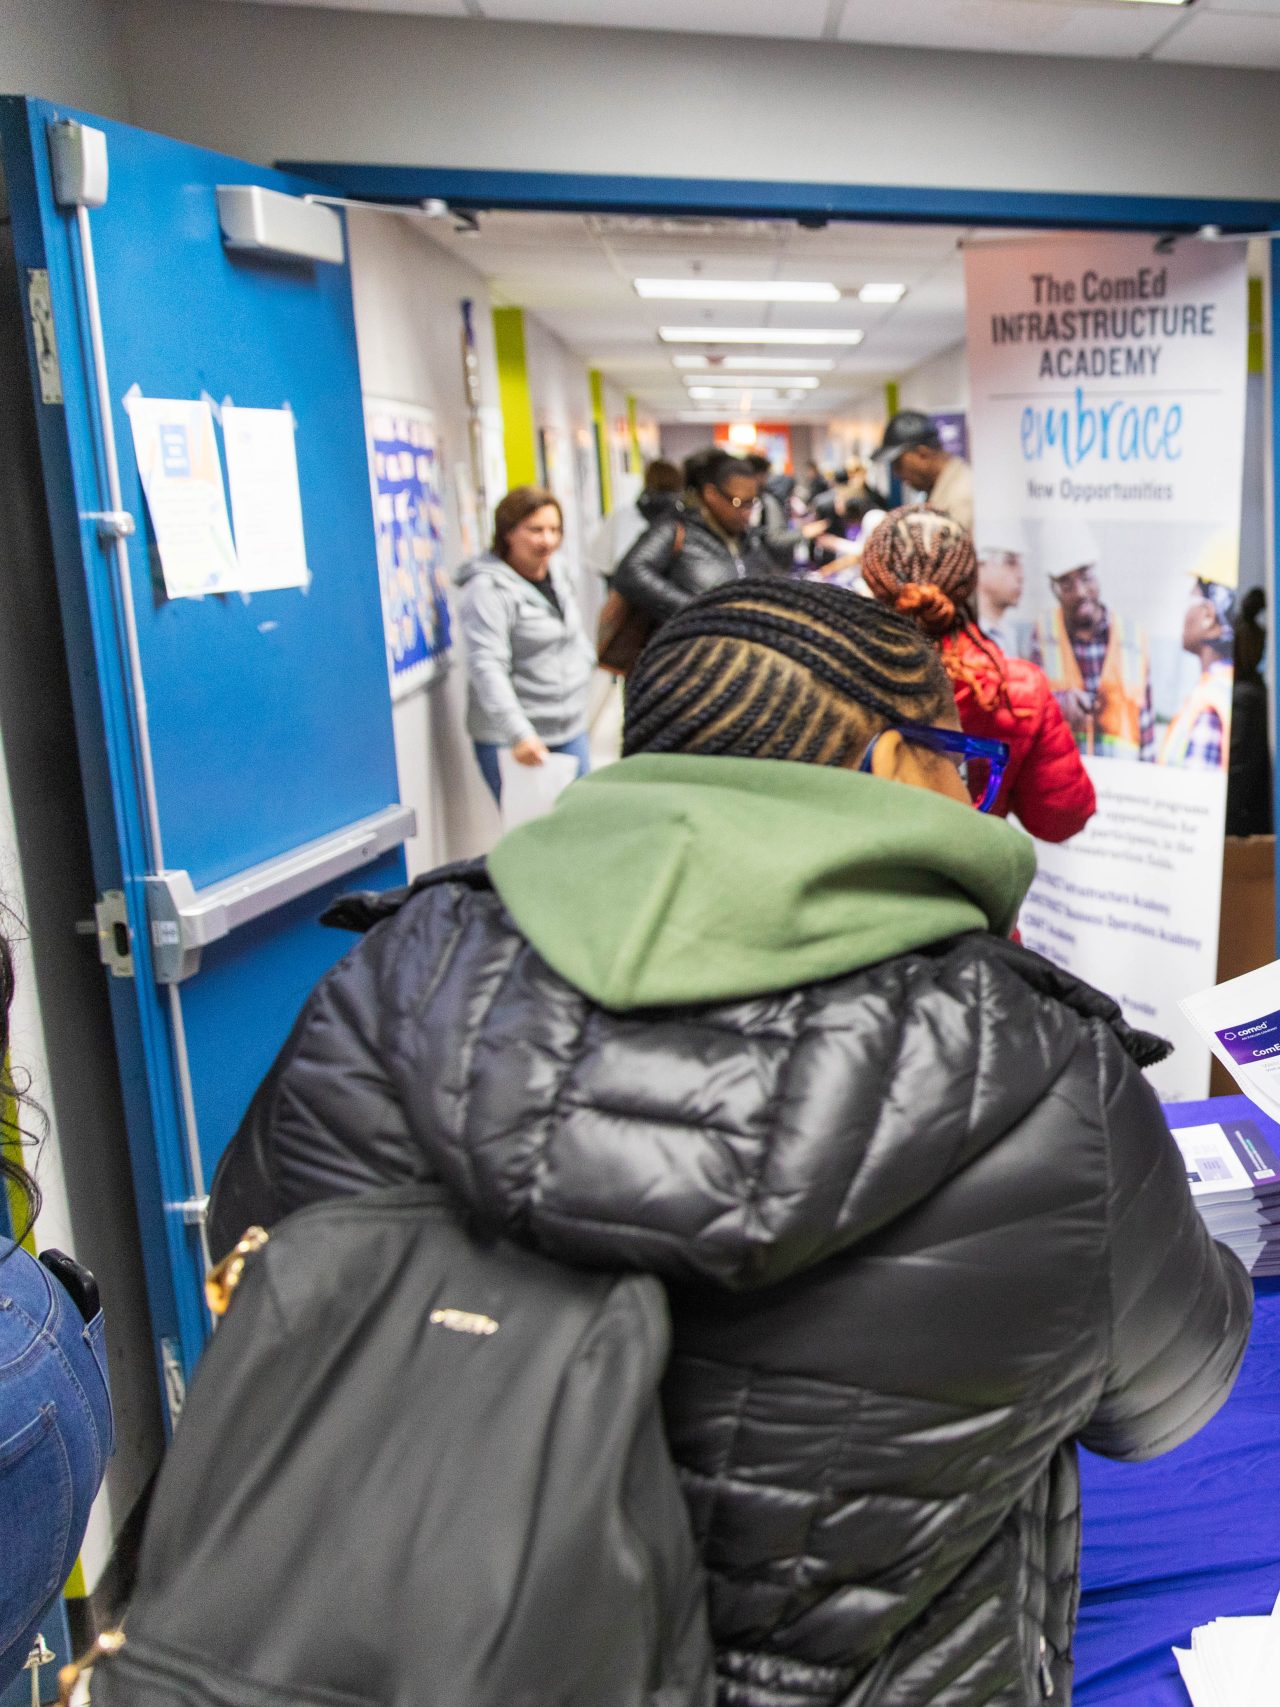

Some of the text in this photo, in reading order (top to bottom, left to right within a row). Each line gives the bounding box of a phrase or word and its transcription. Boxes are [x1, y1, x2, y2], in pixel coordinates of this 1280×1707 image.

[1031, 267, 1167, 304] The ComEd
[991, 304, 1215, 345] INFRASTRUCTURE
[1039, 345, 1162, 379] ACADEMY
[1020, 386, 1182, 469] embrace
[1237, 1021, 1268, 1037] comed
